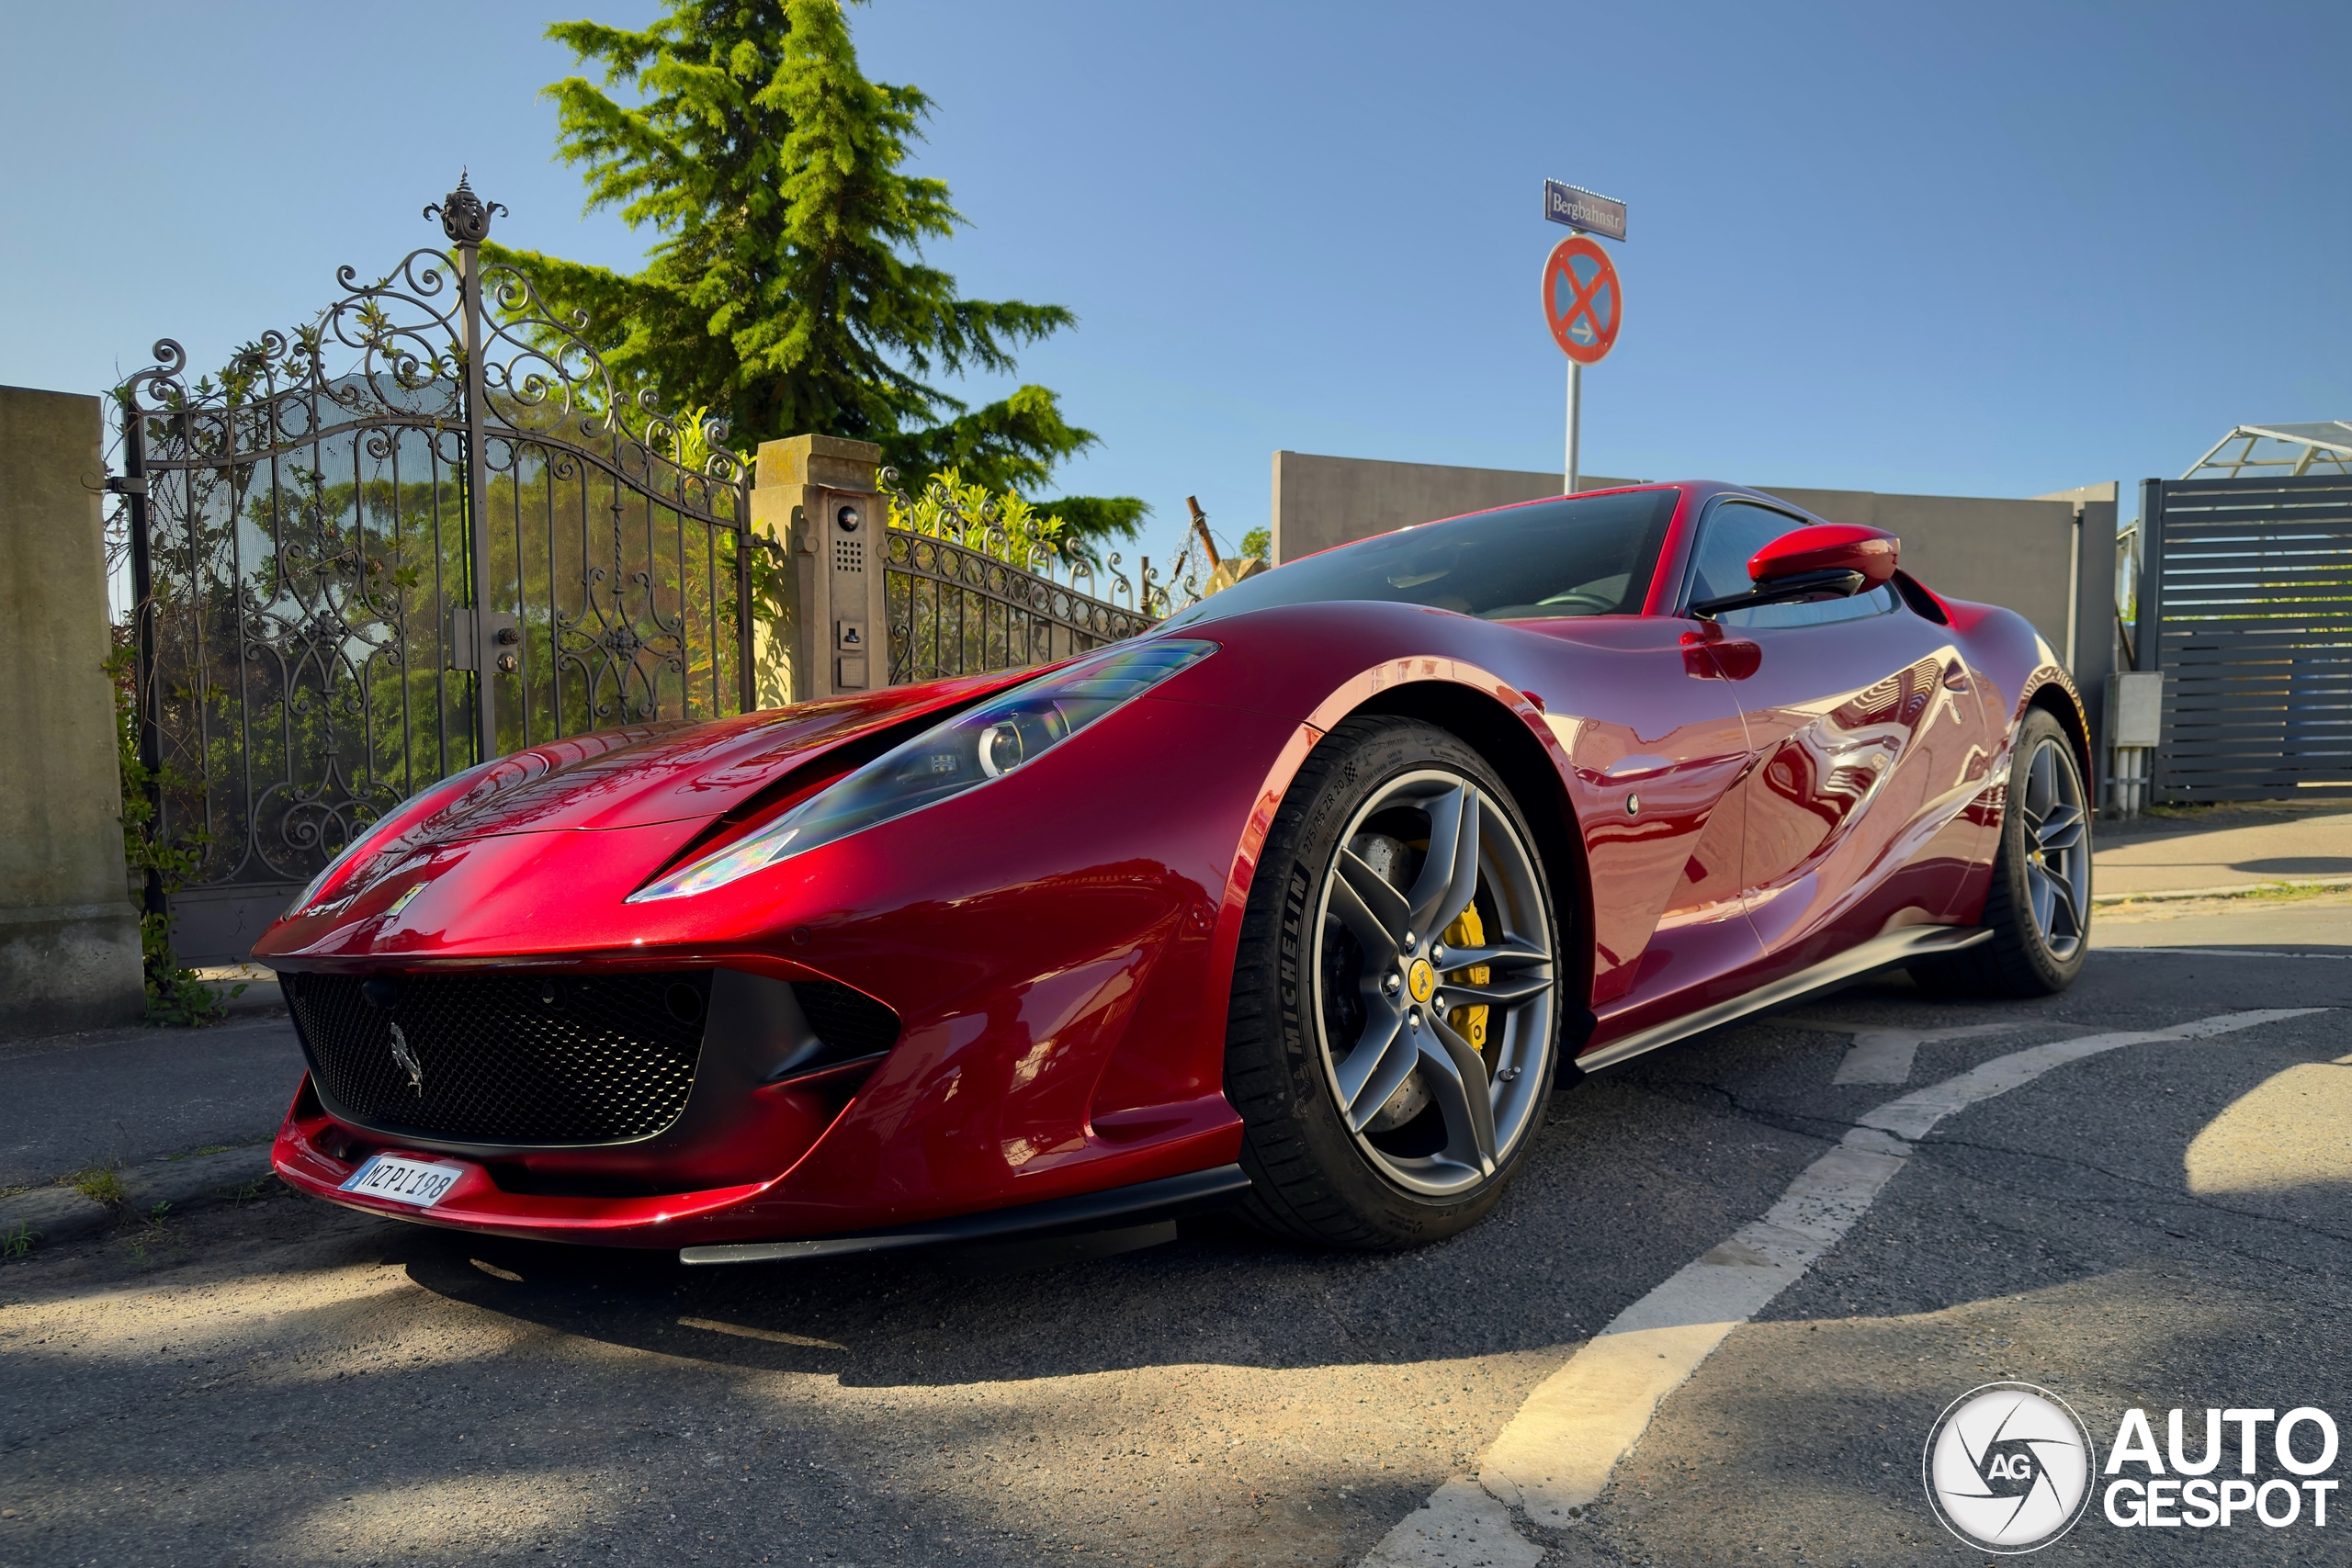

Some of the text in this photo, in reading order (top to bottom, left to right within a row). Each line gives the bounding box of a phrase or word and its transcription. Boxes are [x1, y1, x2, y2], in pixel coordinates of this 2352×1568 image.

[1553, 192, 1622, 230] Bergbahnstr.
[1304, 780, 1344, 854] 275/35 ZR 20
[1281, 872, 1306, 1055] MICHELIN
[362, 1165, 394, 1188] MZ
[405, 1172, 452, 1199] 198
